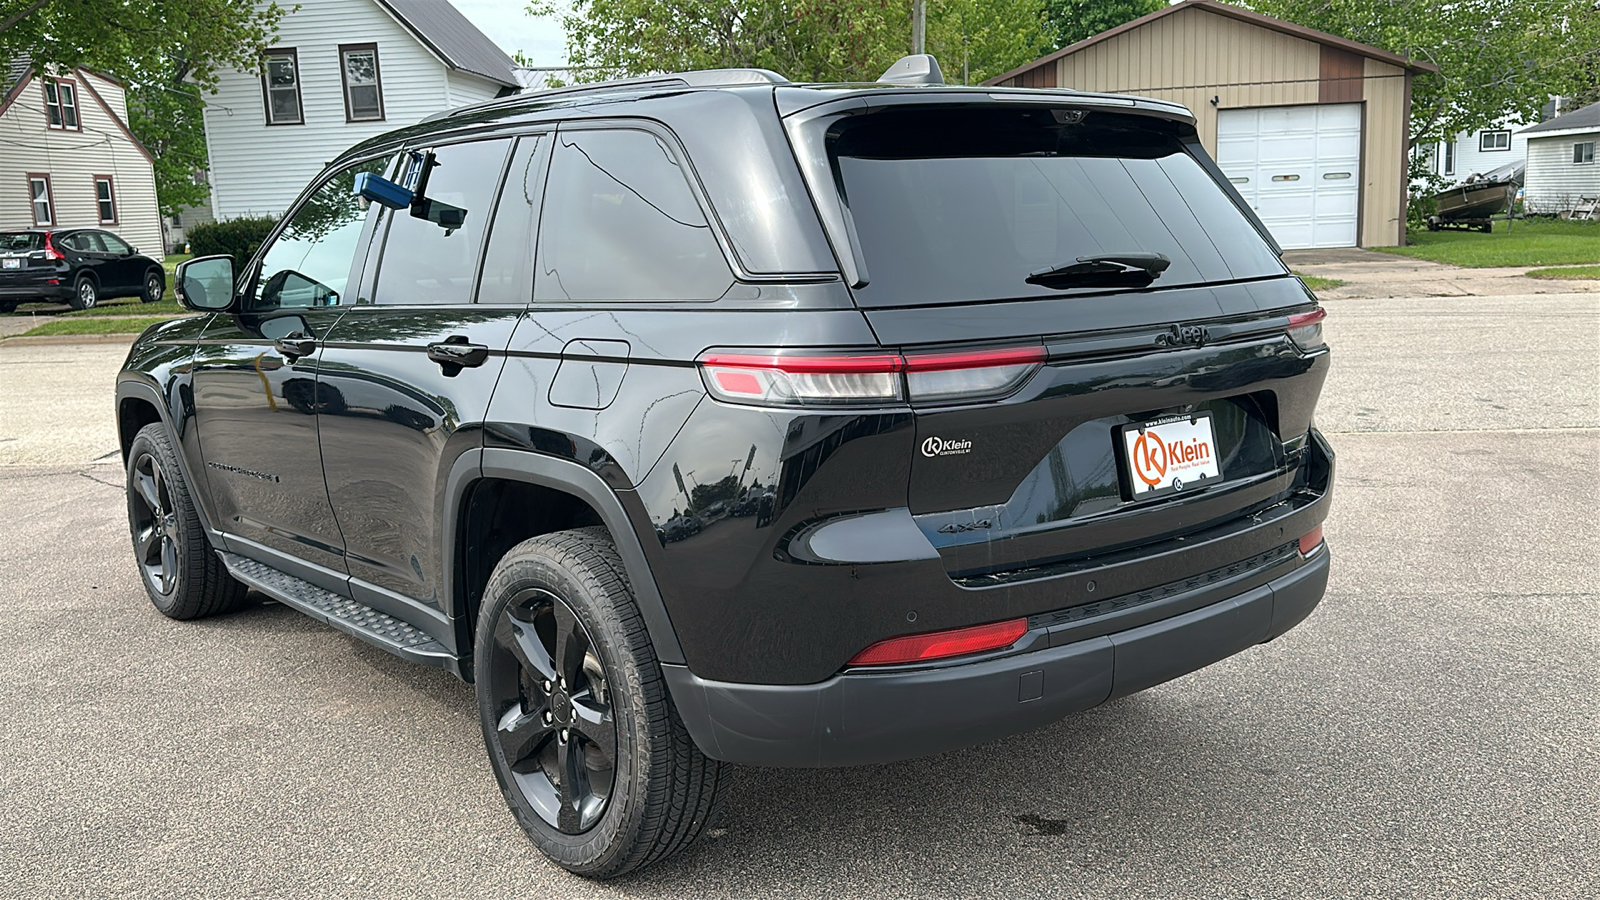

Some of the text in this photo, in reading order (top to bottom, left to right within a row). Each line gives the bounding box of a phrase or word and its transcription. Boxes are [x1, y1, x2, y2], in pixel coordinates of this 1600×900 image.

[1164, 323, 1211, 347] Jeep
[943, 439, 972, 450] Klein
[1167, 437, 1210, 465] Klein
